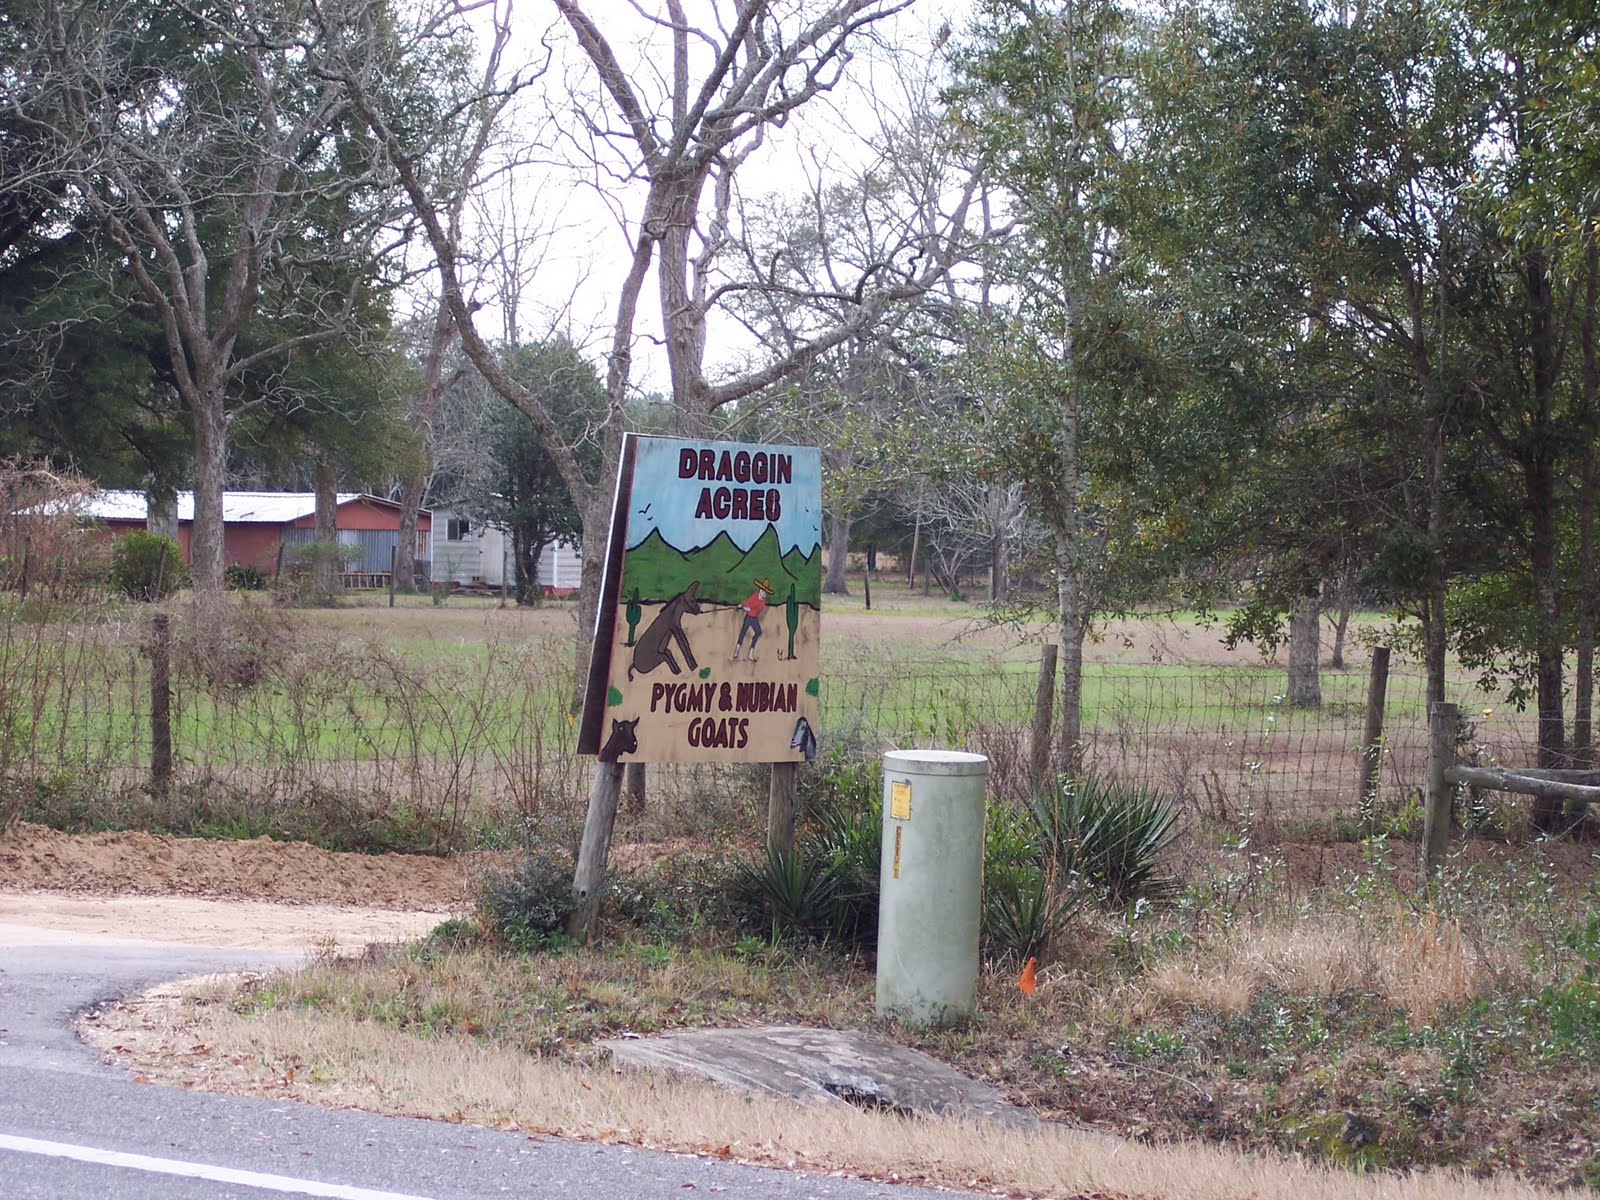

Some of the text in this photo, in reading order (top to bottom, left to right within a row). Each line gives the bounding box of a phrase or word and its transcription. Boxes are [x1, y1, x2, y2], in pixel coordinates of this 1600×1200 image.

[678, 448, 792, 484] DRAGGIN
[695, 487, 781, 522] ACRES
[650, 682, 798, 713] PYGMY & NUBIAN
[687, 717, 749, 749] GOATS
